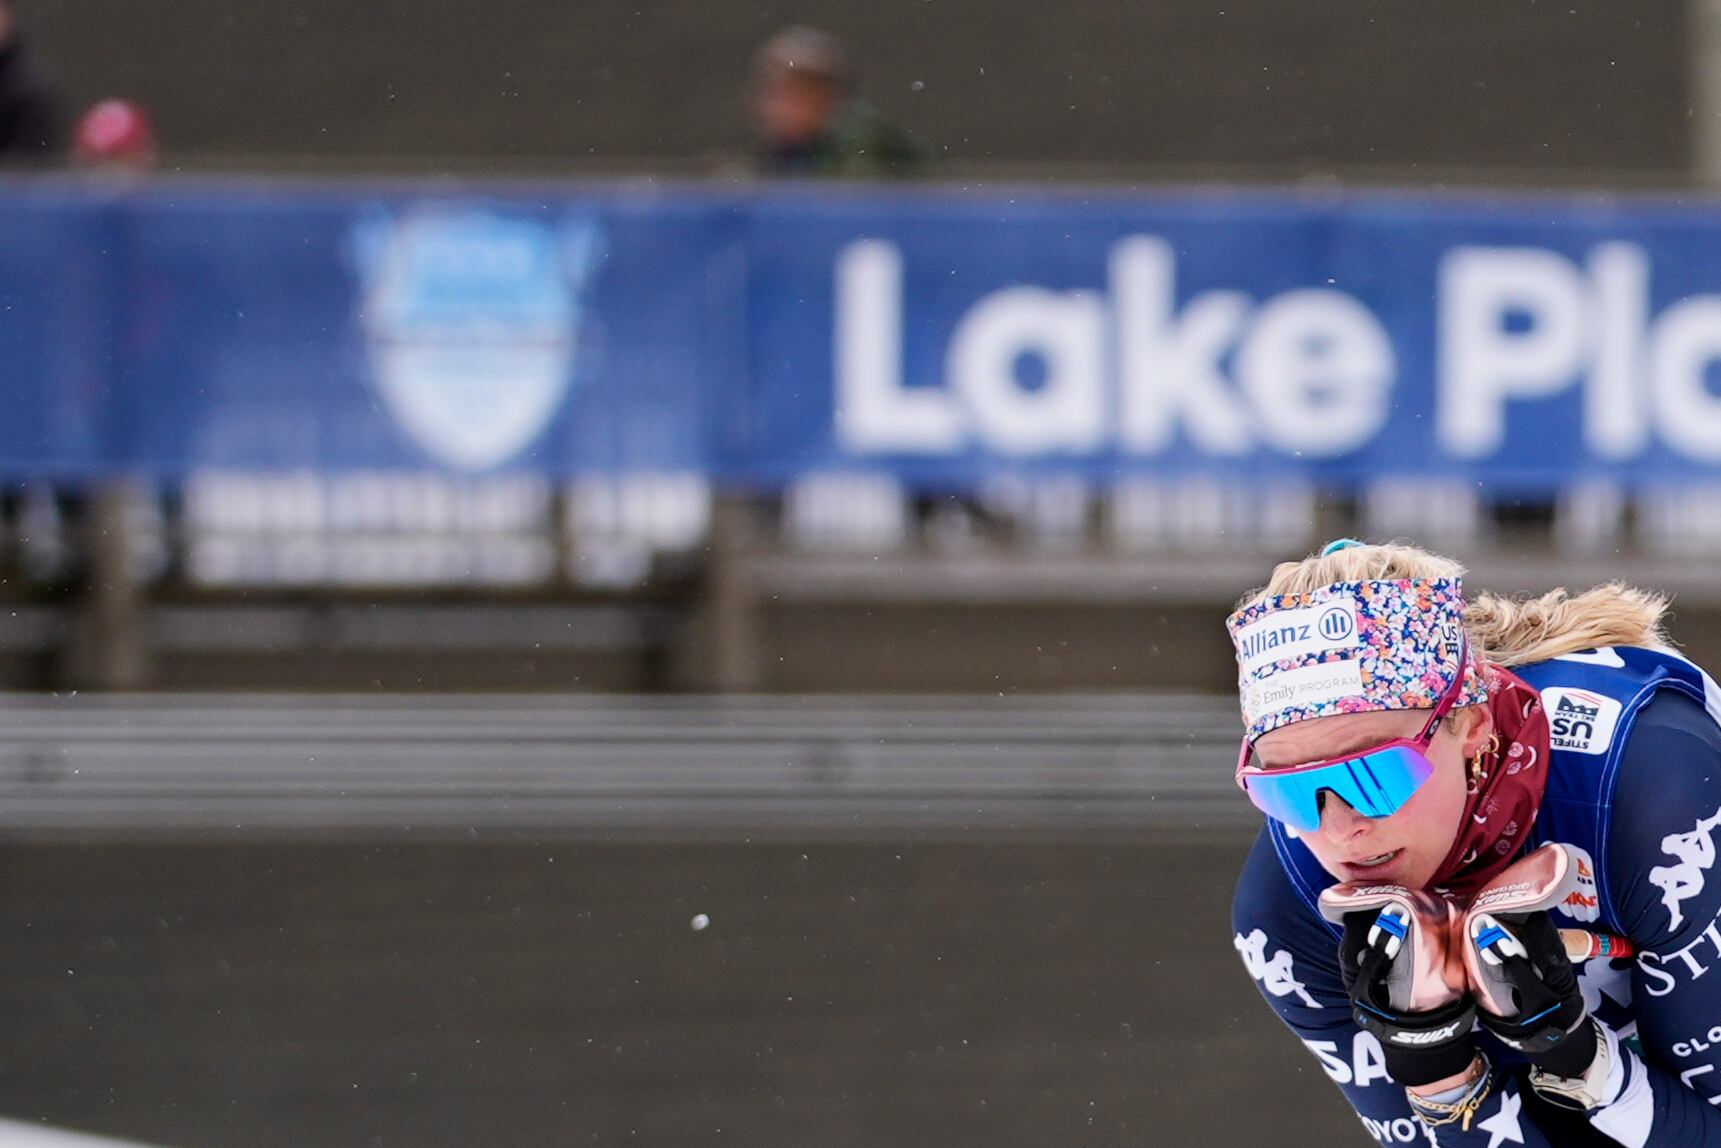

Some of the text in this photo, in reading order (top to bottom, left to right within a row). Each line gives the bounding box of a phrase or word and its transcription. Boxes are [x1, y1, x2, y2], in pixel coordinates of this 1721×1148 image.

[837, 236, 1396, 458] Lake
[1240, 623, 1311, 660] Allianz
[1441, 625, 1458, 641] US
[1263, 676, 1360, 705] Emily PROGRAM
[1552, 718, 1593, 740] US
